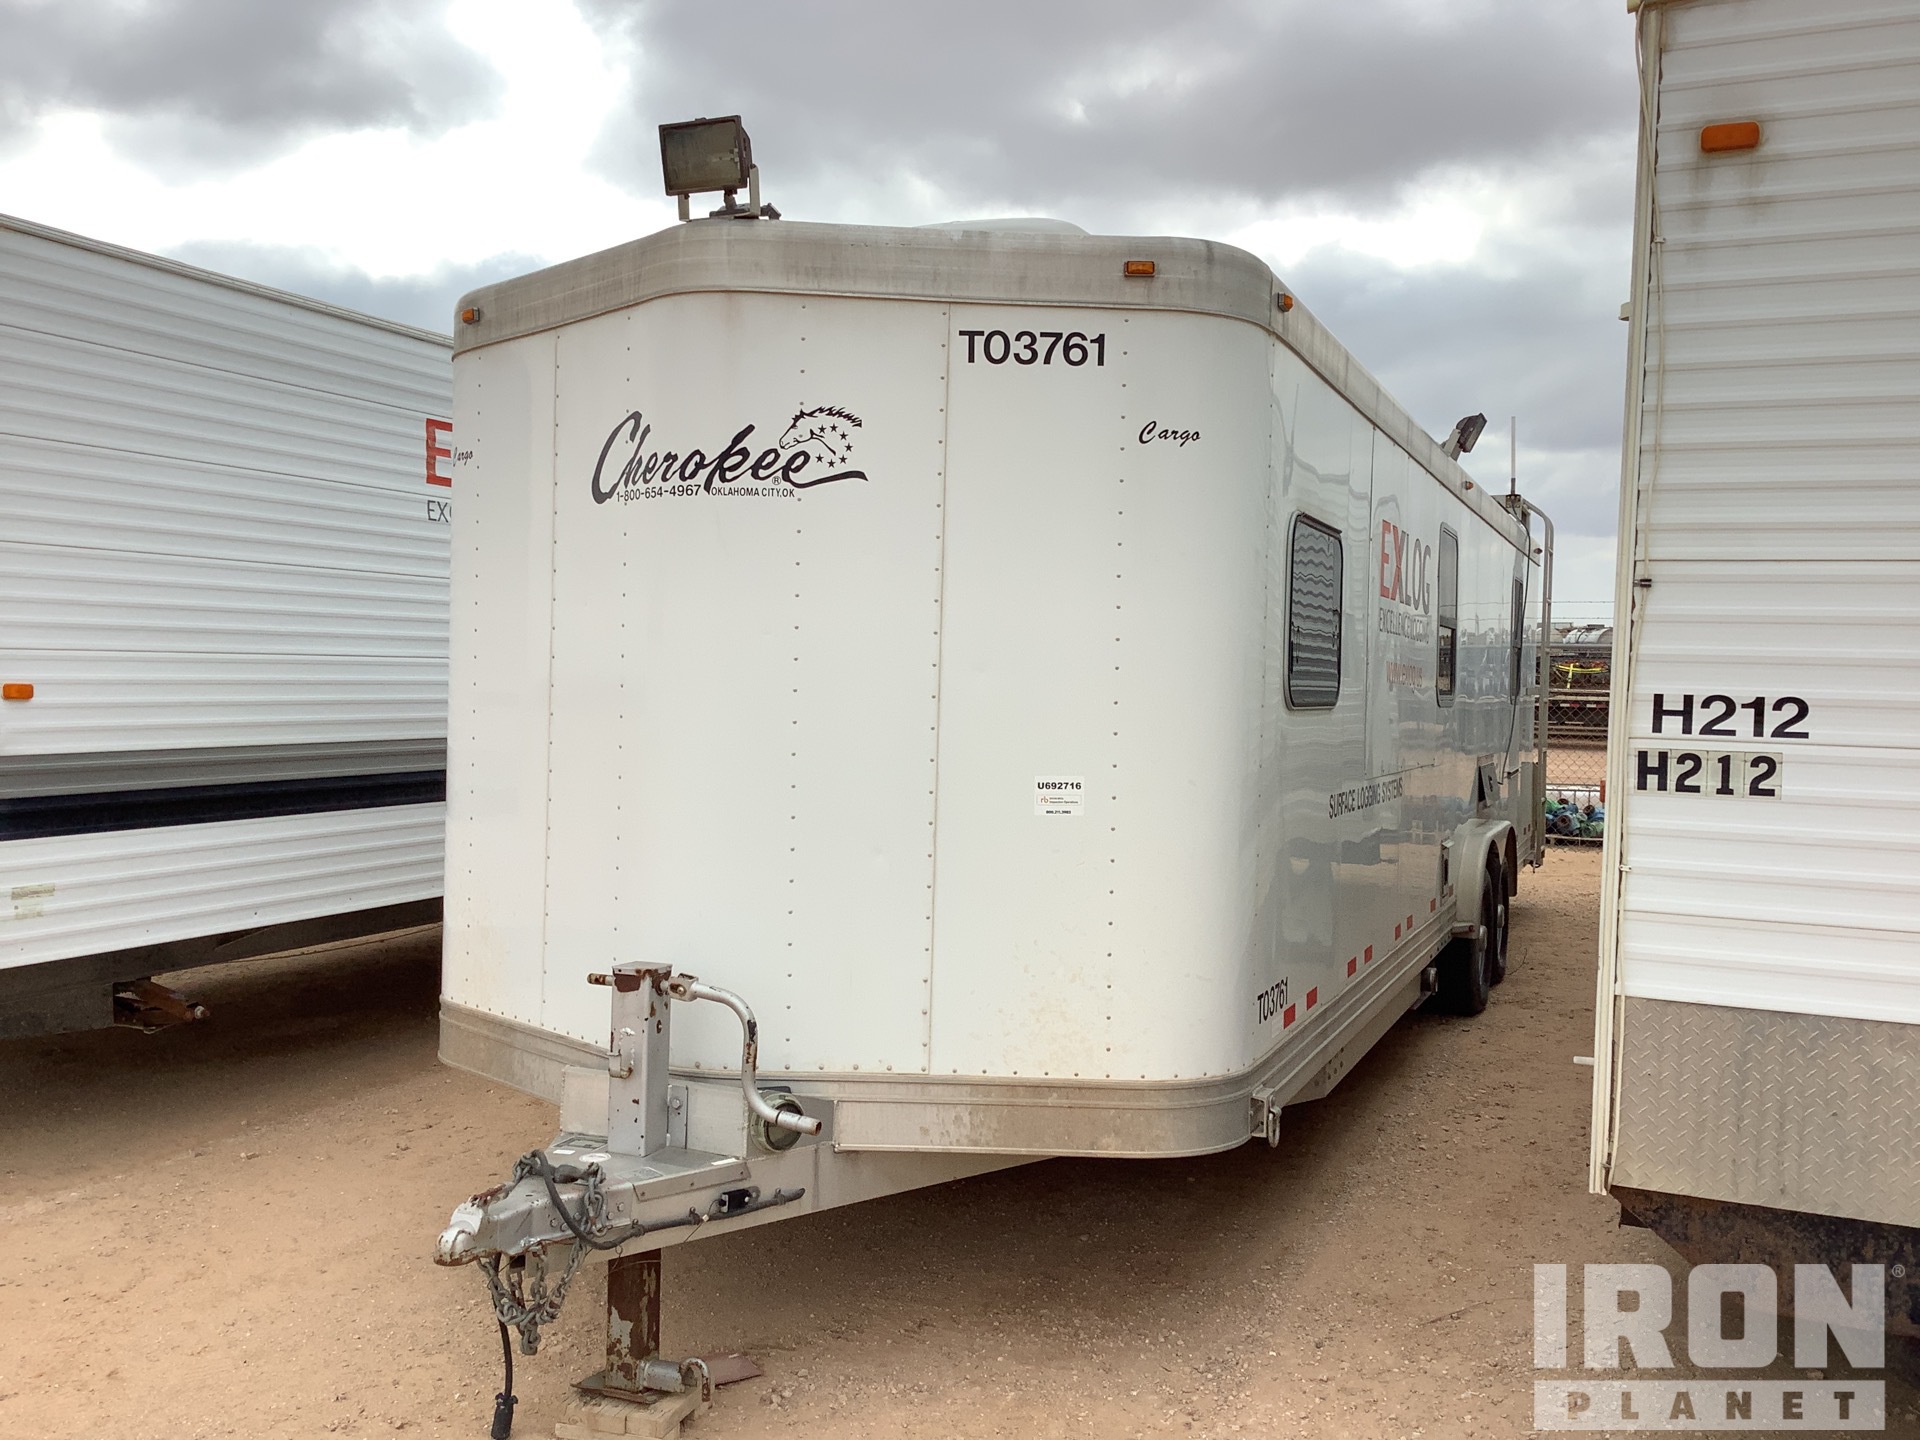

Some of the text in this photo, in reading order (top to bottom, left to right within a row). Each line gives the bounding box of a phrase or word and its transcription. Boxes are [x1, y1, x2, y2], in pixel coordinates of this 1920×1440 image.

[1138, 420, 1201, 448] Cargo
[591, 410, 868, 505] Cherokee
[616, 484, 702, 503] 1-800-654-4967
[711, 487, 760, 498] OKLAHOMA
[426, 499, 452, 523] EX
[1380, 519, 1432, 616] EXLOG
[1651, 693, 1810, 740] H212
[1037, 781, 1082, 790] U692716
[1636, 750, 1778, 797] H212
[1328, 789, 1356, 820] SURFACE
